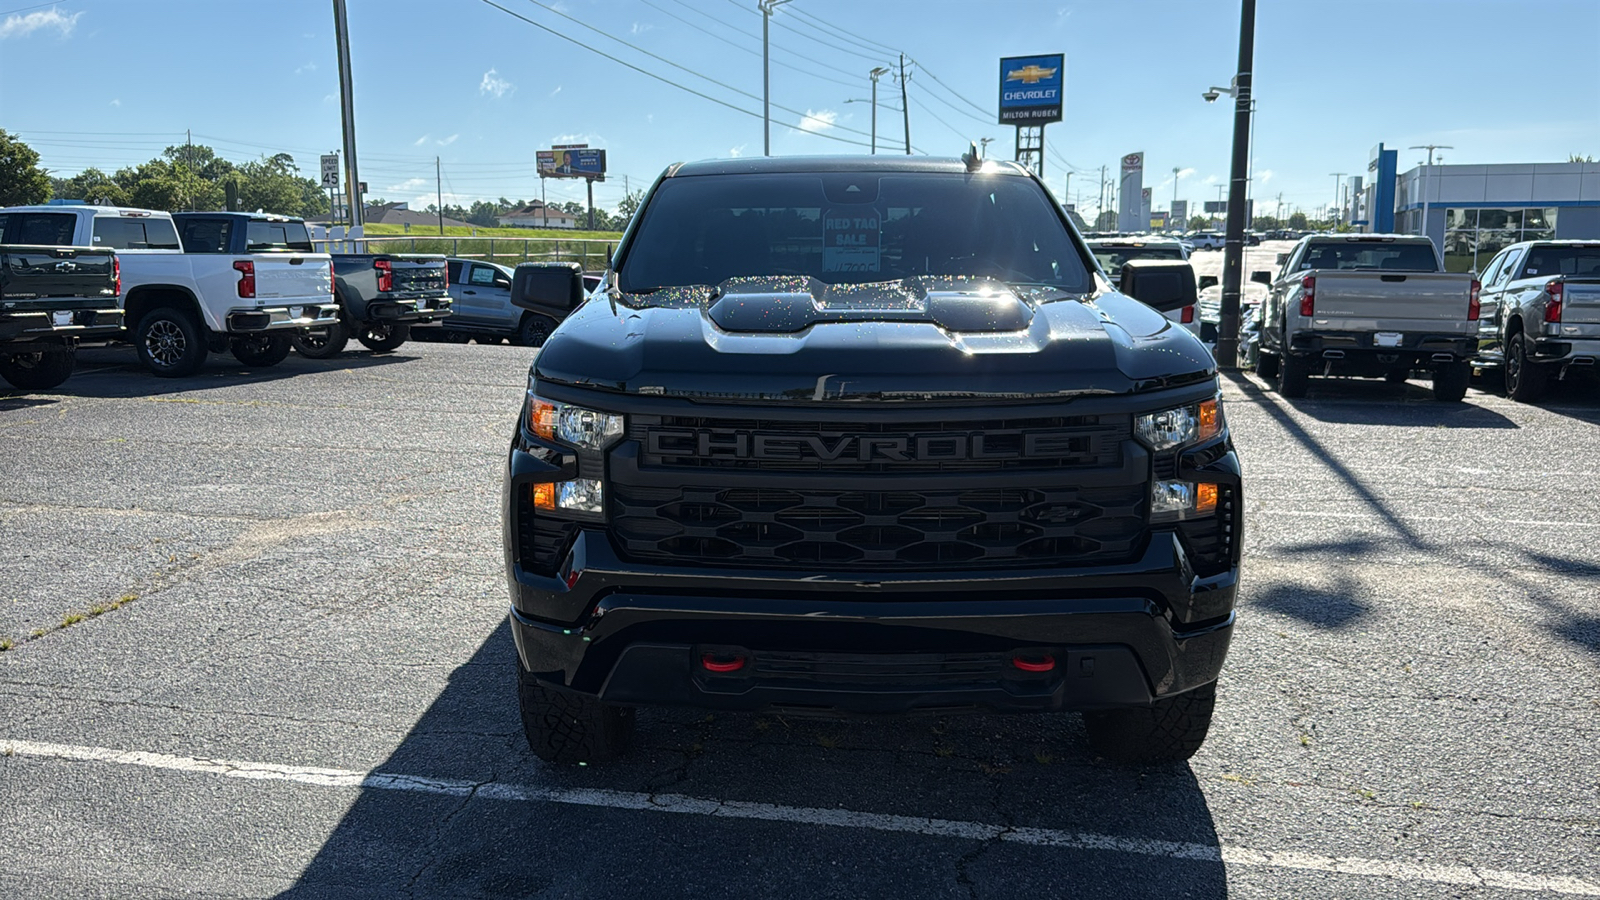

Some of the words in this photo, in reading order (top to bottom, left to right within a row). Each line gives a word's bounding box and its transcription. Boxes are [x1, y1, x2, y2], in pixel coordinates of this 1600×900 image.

[1004, 90, 1056, 101] CHEVROLET
[1002, 111, 1029, 119] MILTON
[1032, 109, 1058, 117] RUBEN
[322, 173, 338, 184] 45
[826, 218, 850, 230] RED
[854, 218, 878, 230] TAG
[836, 234, 867, 245] SALE
[648, 428, 1116, 461] CHEVROLET
